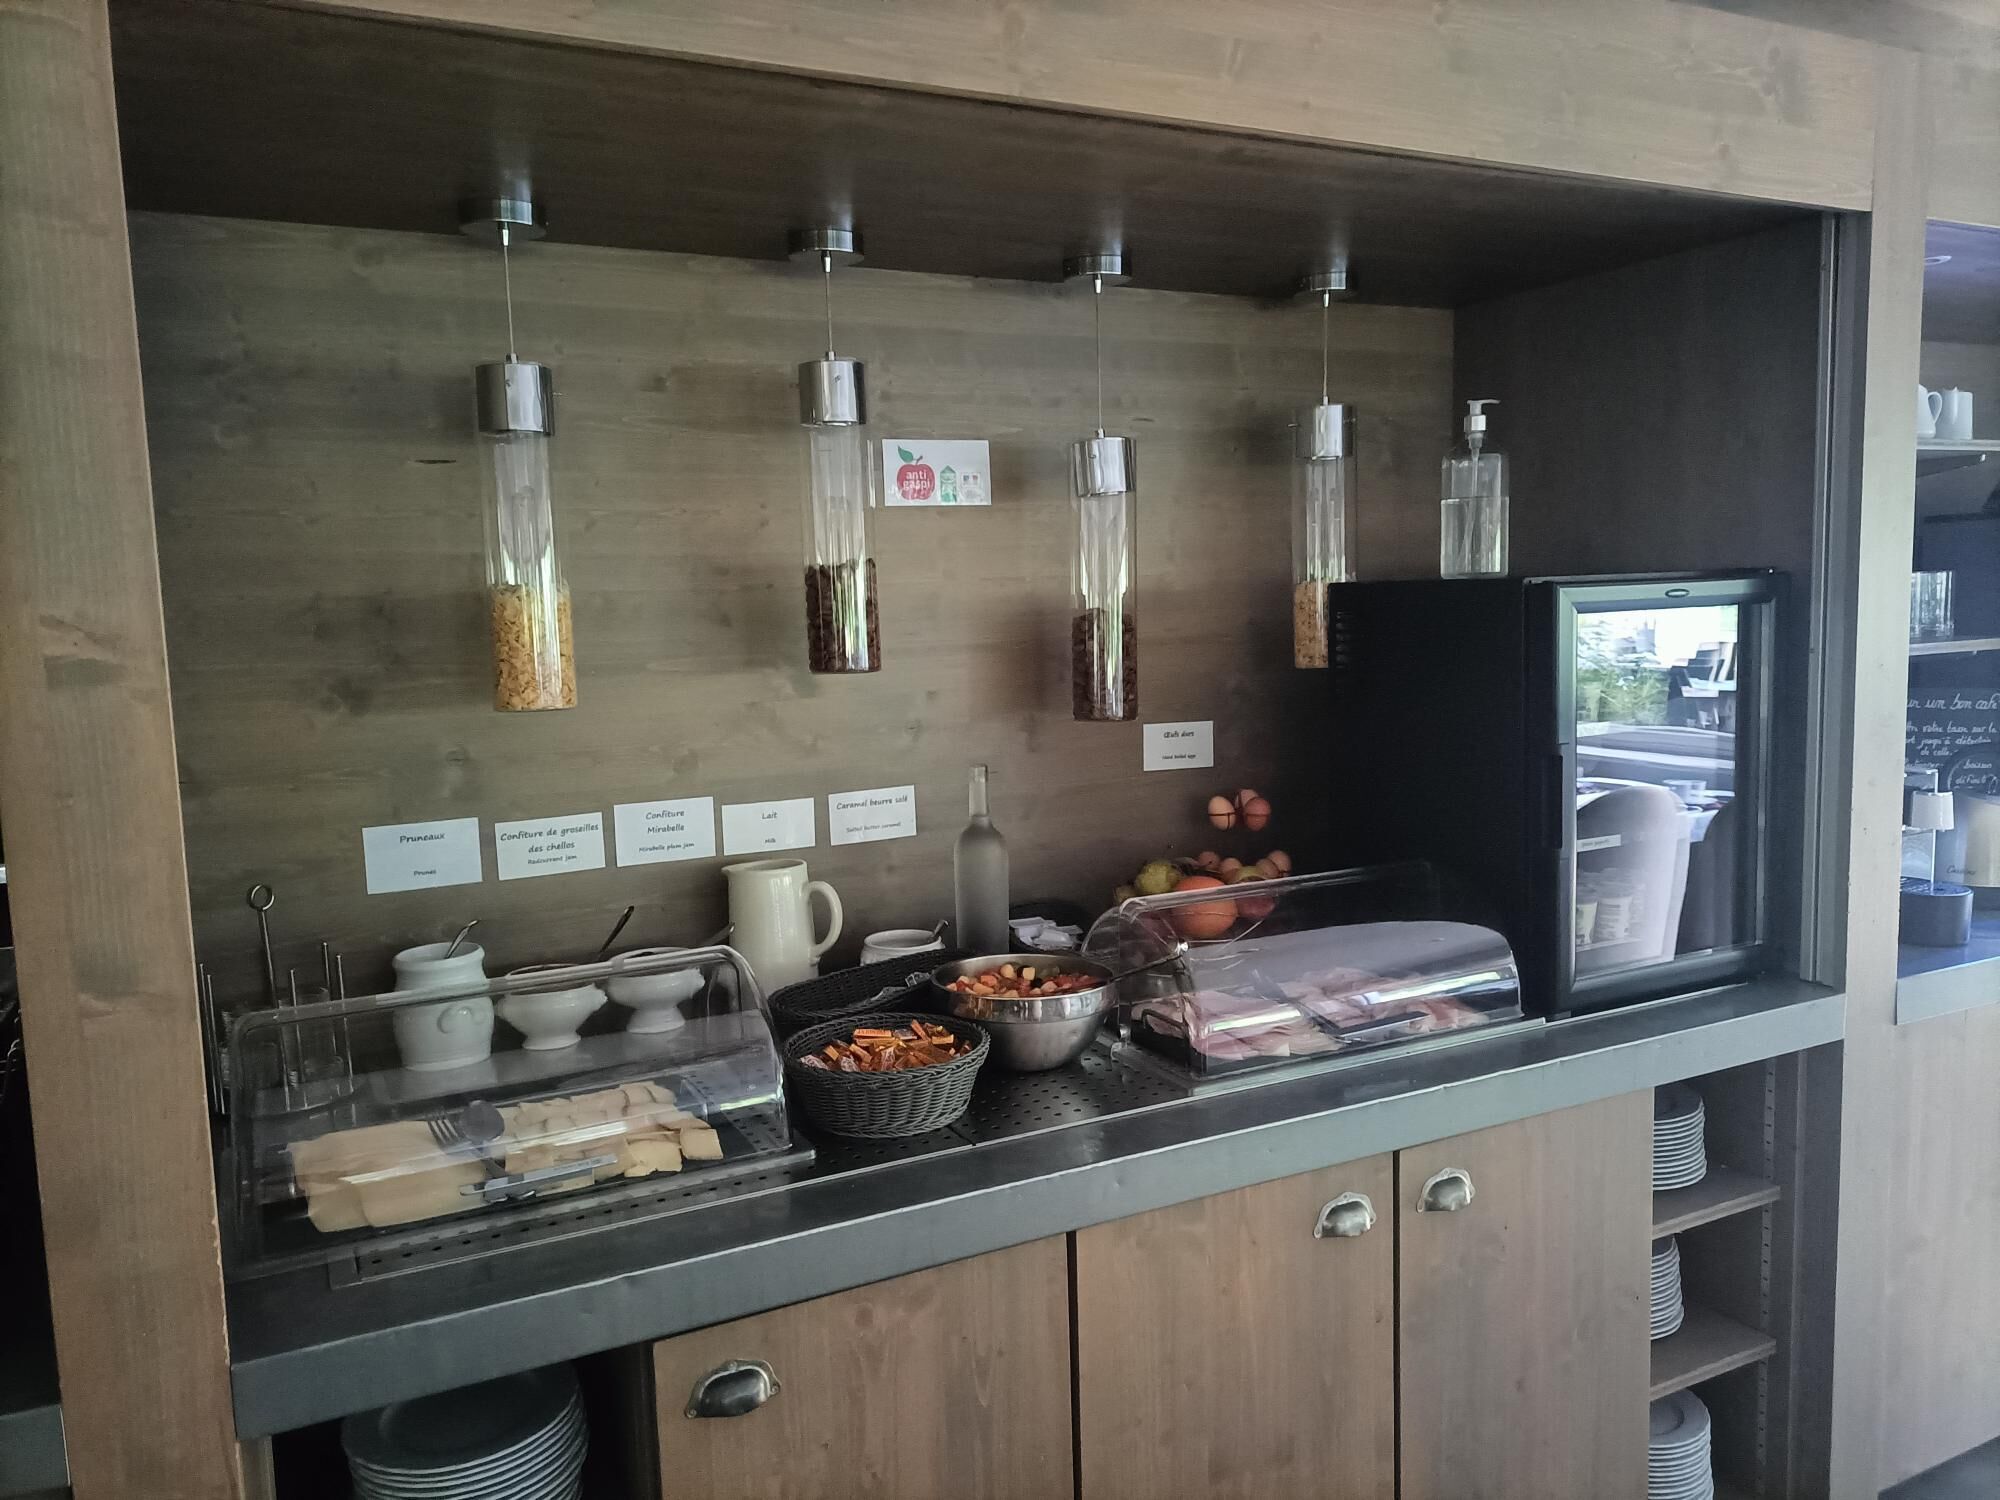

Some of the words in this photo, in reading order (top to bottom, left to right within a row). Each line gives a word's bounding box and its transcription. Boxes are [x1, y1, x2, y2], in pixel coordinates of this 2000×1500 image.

[906, 470, 927, 479] anti
[903, 479, 930, 491] gaspi
[1950, 692, 1972, 710] bon
[836, 799, 867, 810] Caramel
[869, 798, 892, 806] beurre
[645, 809, 685, 820] Confiture
[761, 811, 777, 819] Lait
[500, 830, 543, 841] Confiture
[546, 828, 557, 836] de
[560, 823, 599, 837] groseilles
[647, 823, 685, 834] Mirabelle
[400, 833, 446, 843] Pruneaux
[528, 845, 543, 853] des
[666, 843, 682, 851] plum
[683, 842, 695, 850] jam
